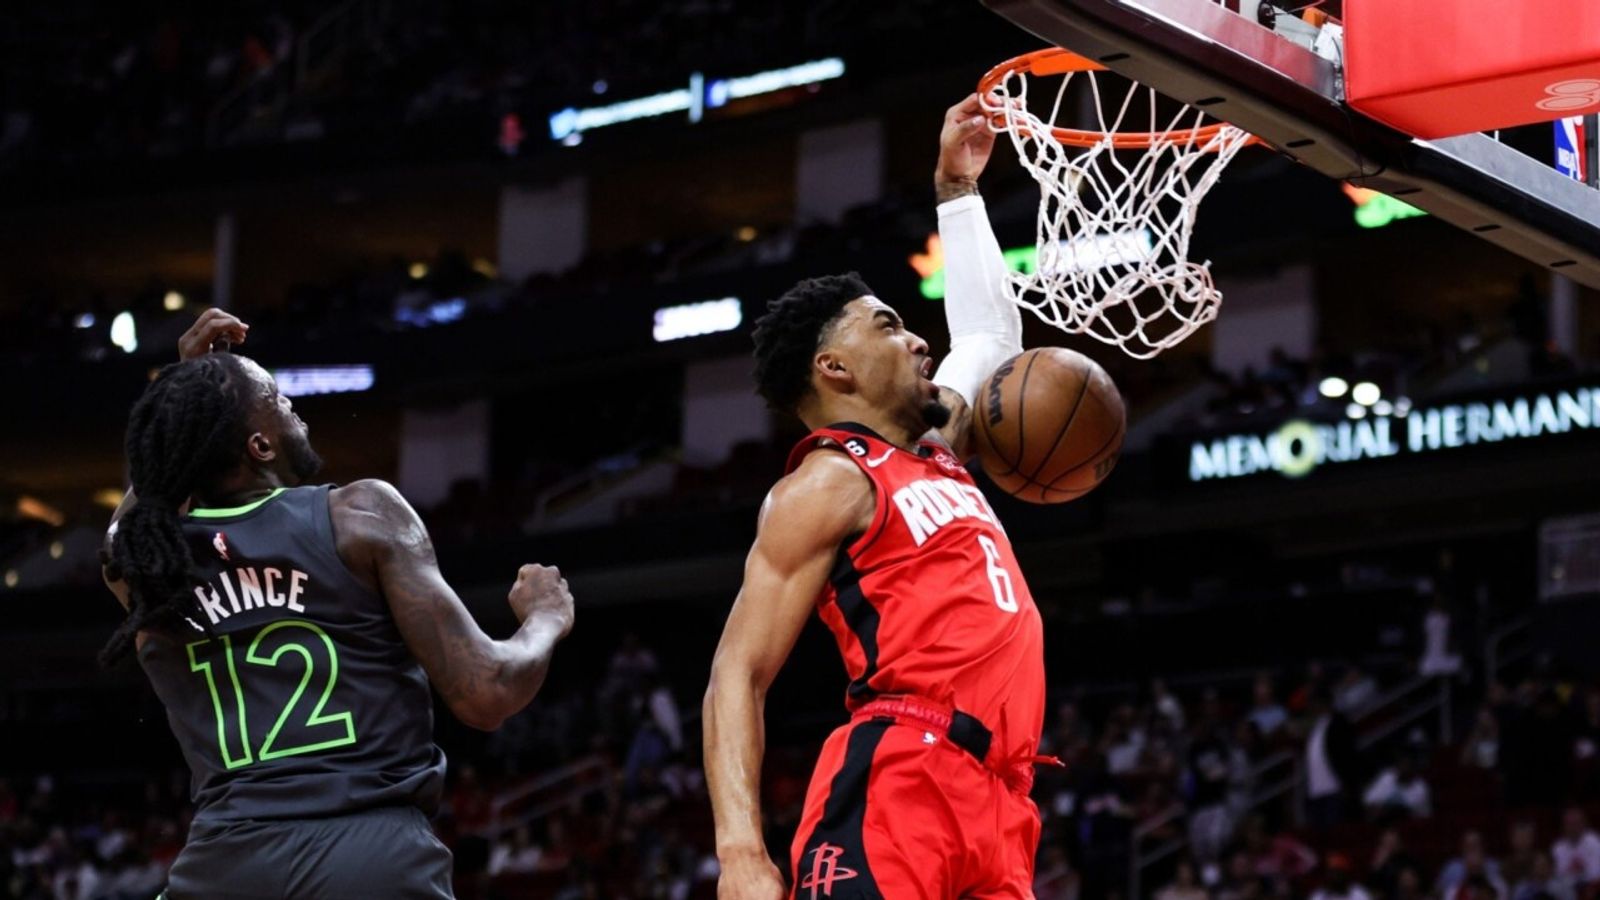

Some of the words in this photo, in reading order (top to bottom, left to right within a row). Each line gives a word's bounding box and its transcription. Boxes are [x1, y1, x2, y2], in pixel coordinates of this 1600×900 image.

[1190, 416, 1399, 480] MEMORIAL
[1407, 386, 1600, 453] HERMAN
[892, 478, 1009, 548] ROCKE
[185, 566, 309, 632] RINCE
[976, 534, 1019, 613] 6
[185, 617, 357, 770] 12
